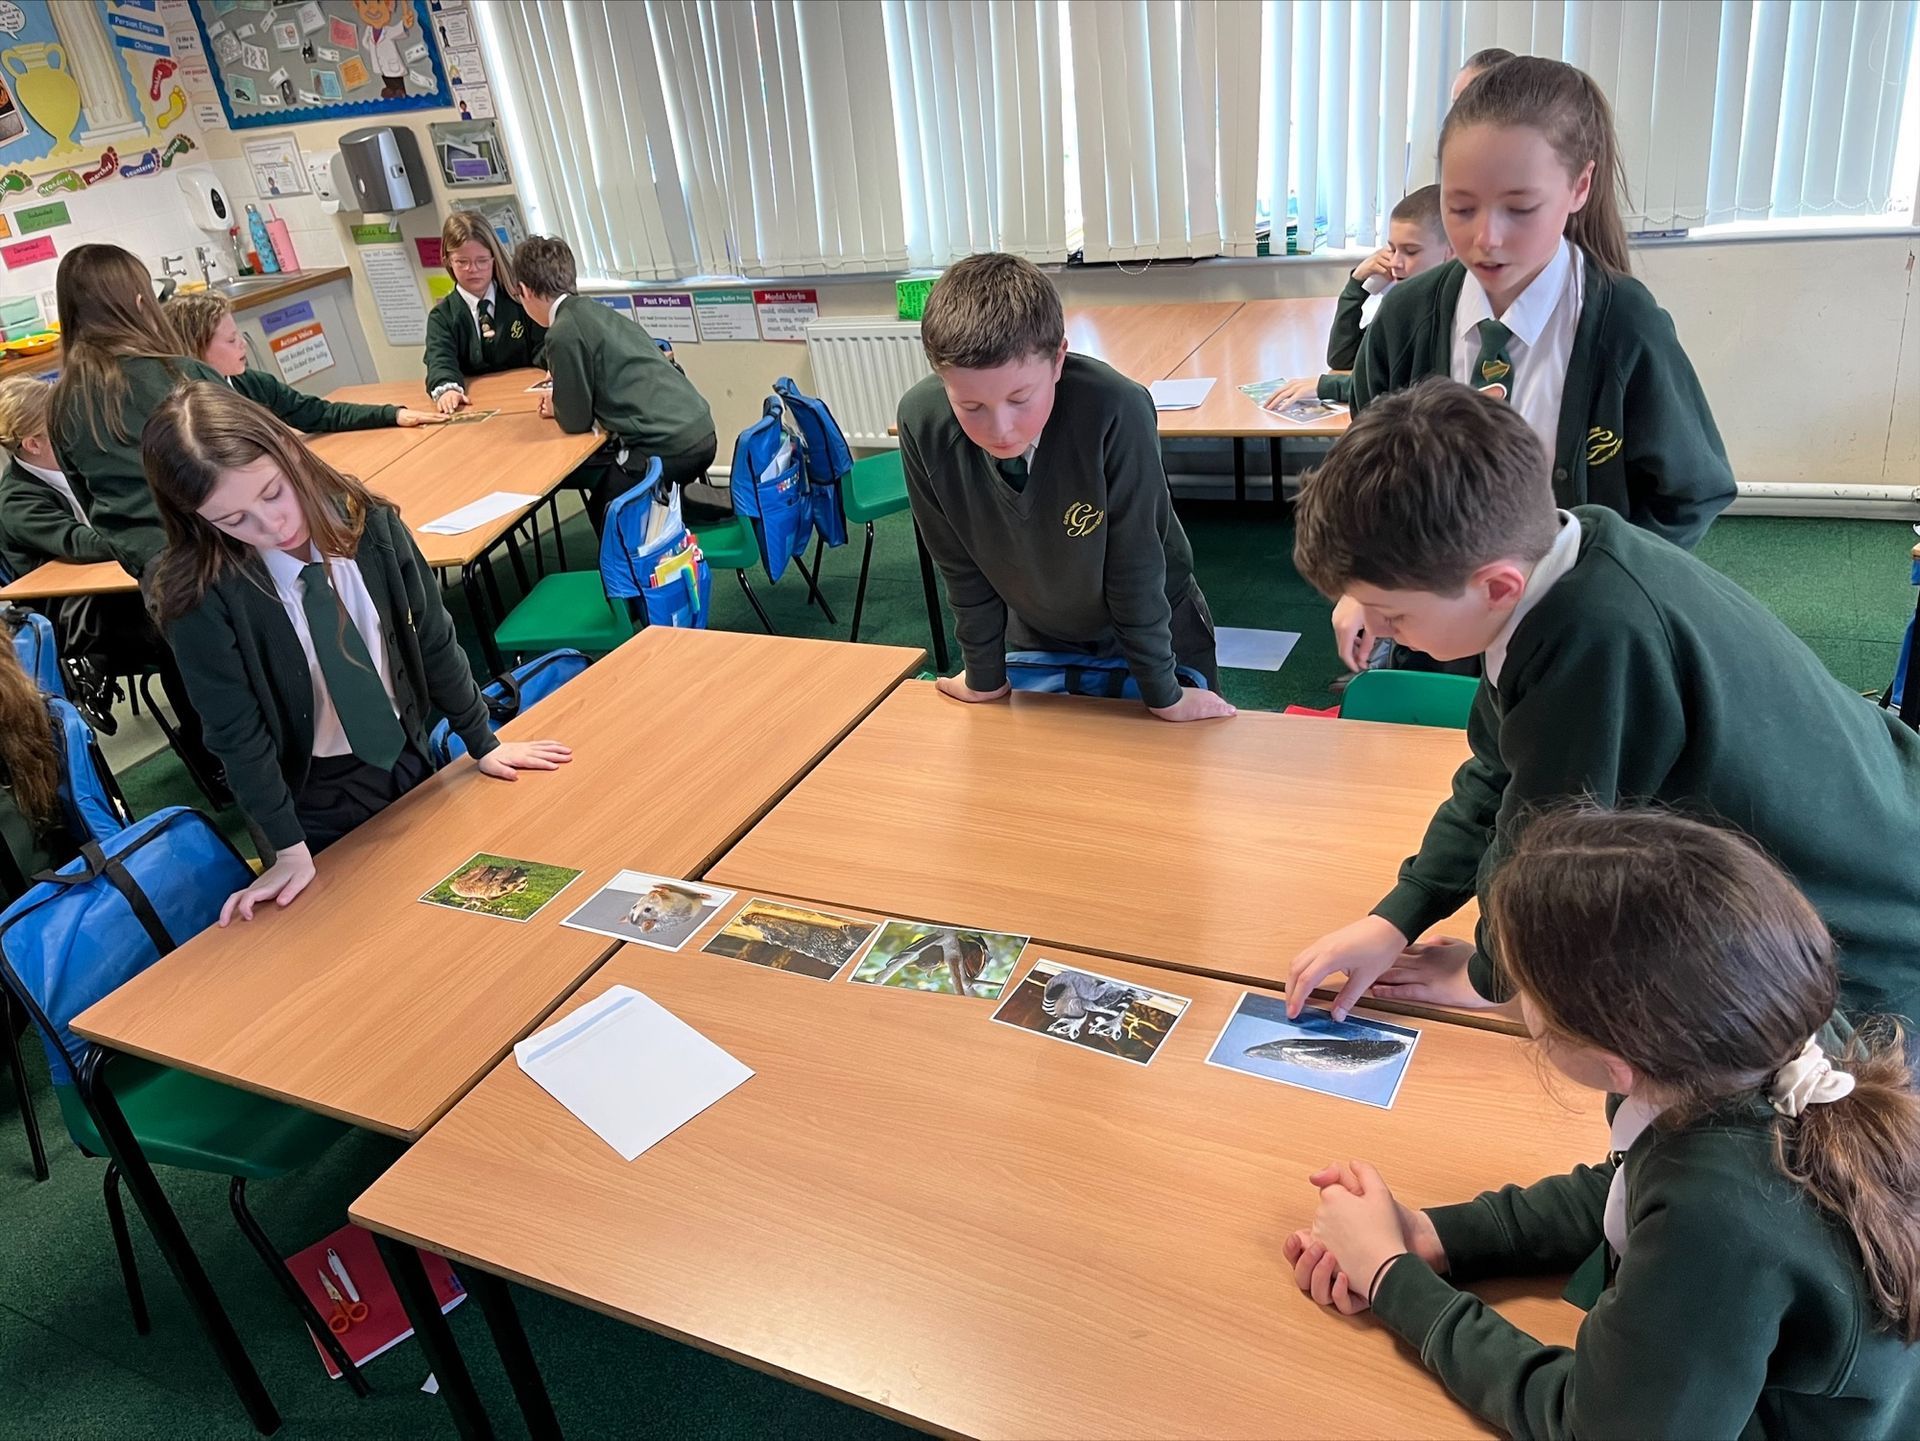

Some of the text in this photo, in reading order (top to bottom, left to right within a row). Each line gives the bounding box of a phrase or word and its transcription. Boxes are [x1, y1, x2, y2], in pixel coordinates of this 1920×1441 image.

[89, 163, 113, 183] marched
[643, 296, 681, 306] Past Perfect
[786, 292, 806, 300] Verbs
[280, 329, 314, 347] Active Voice
